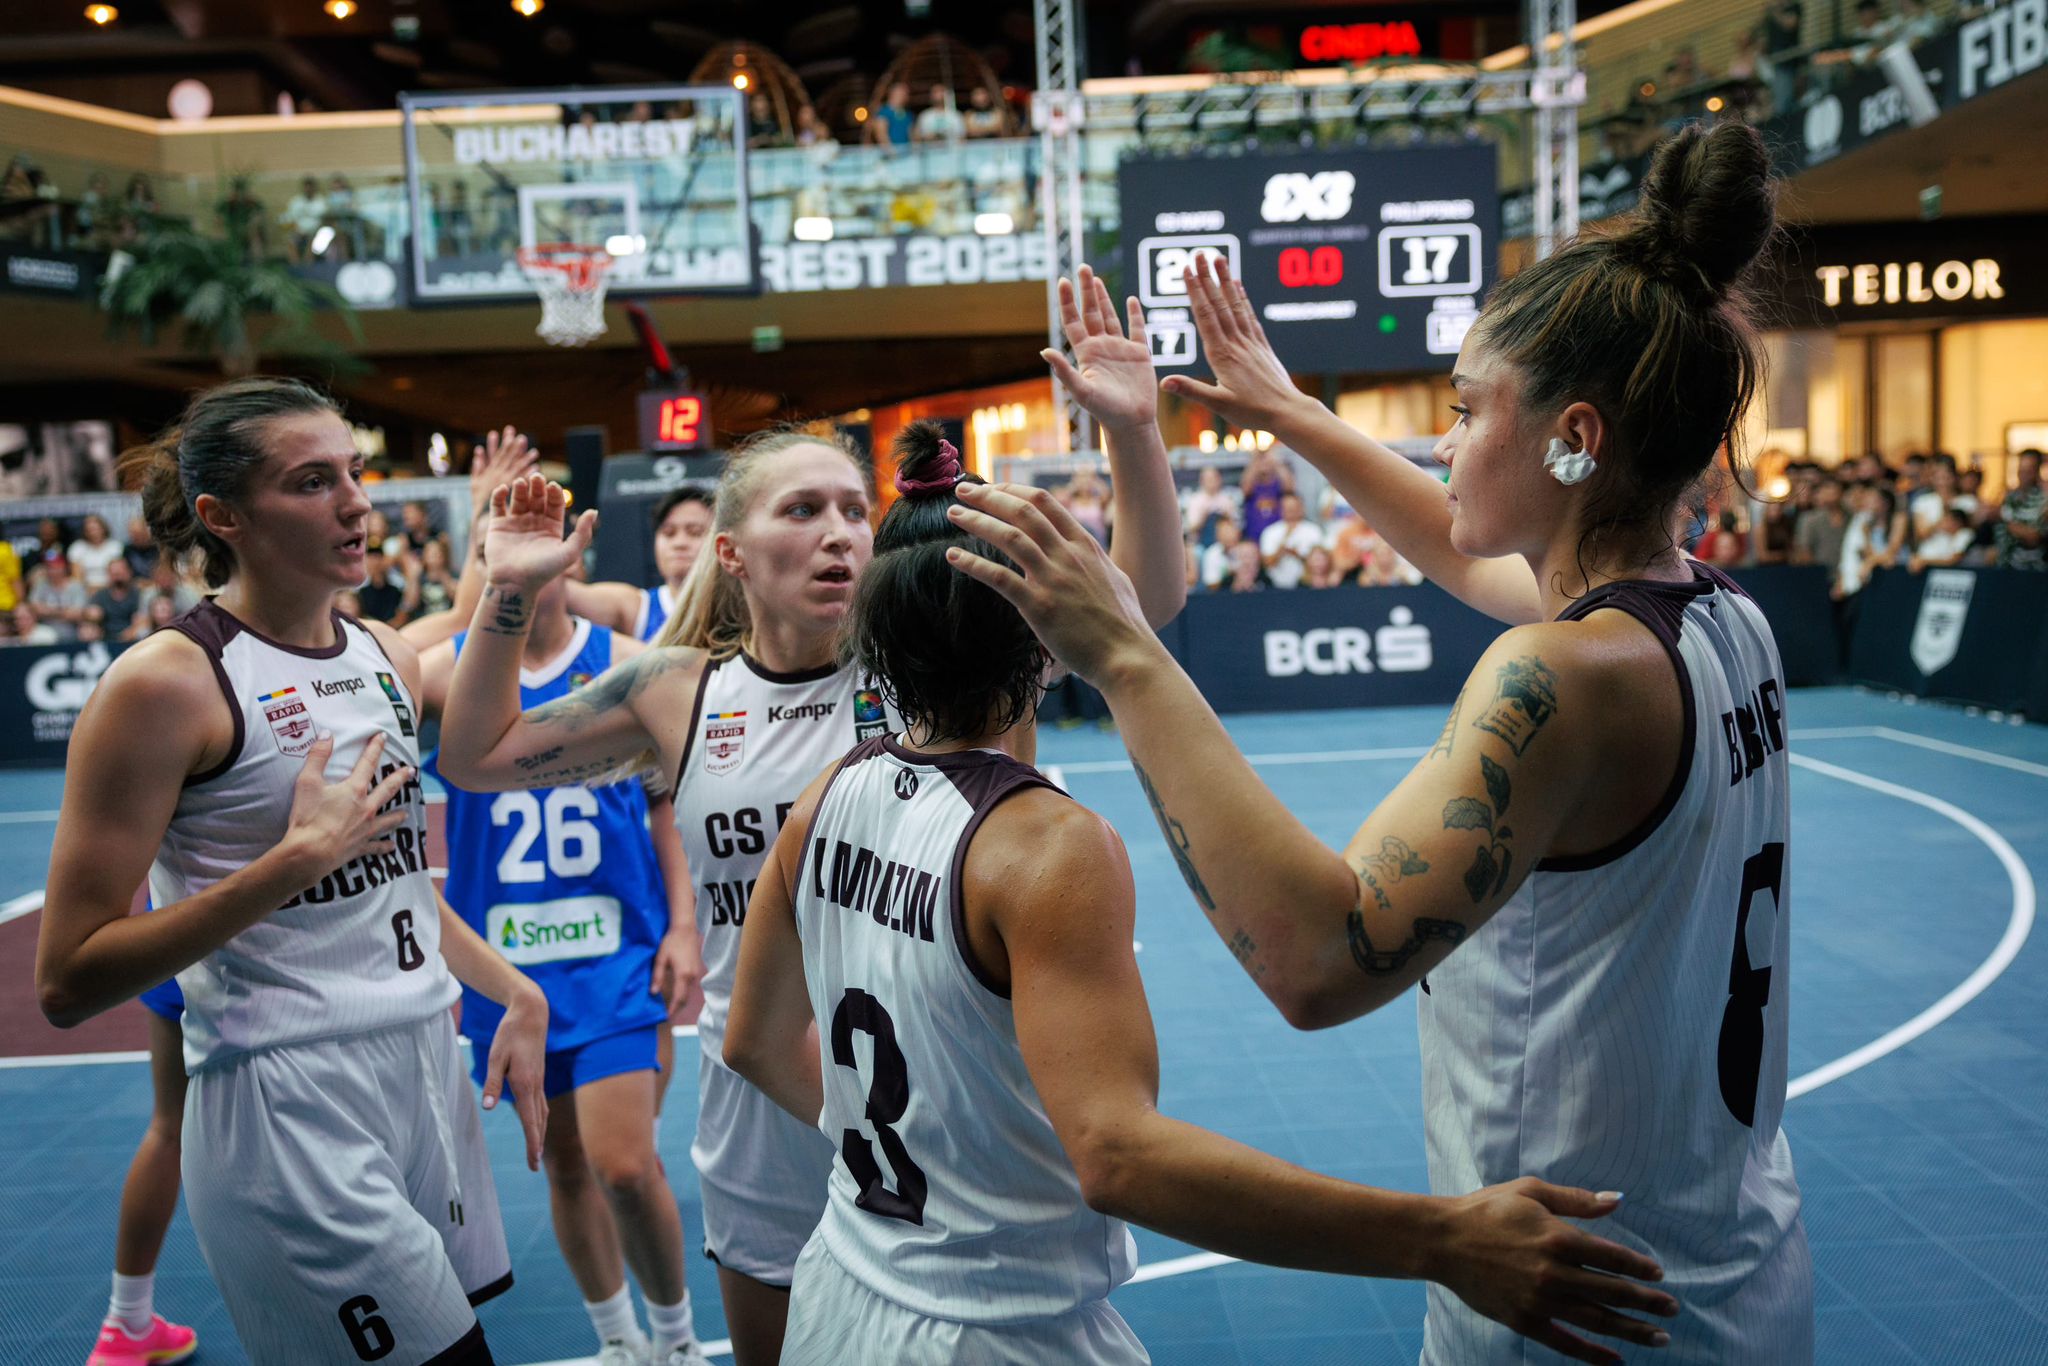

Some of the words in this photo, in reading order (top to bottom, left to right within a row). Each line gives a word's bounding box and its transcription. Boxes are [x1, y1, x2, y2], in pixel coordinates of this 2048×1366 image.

[1958, 0, 2048, 98] FIB
[455, 118, 698, 164] BUCHAREST
[905, 234, 1050, 286] 2025
[1401, 236, 1459, 285] 17
[1816, 258, 2004, 307] TEILOR
[660, 396, 702, 443] 12
[1264, 627, 1374, 677] BCR
[271, 704, 303, 720] RAPID
[311, 677, 366, 698] Kempa
[710, 729, 740, 738] RAPID
[490, 787, 601, 883] 26
[705, 807, 766, 858] CS
[392, 909, 425, 972] 6
[522, 912, 605, 946] Smart
[831, 988, 928, 1226] 3
[338, 1294, 395, 1362] 6
